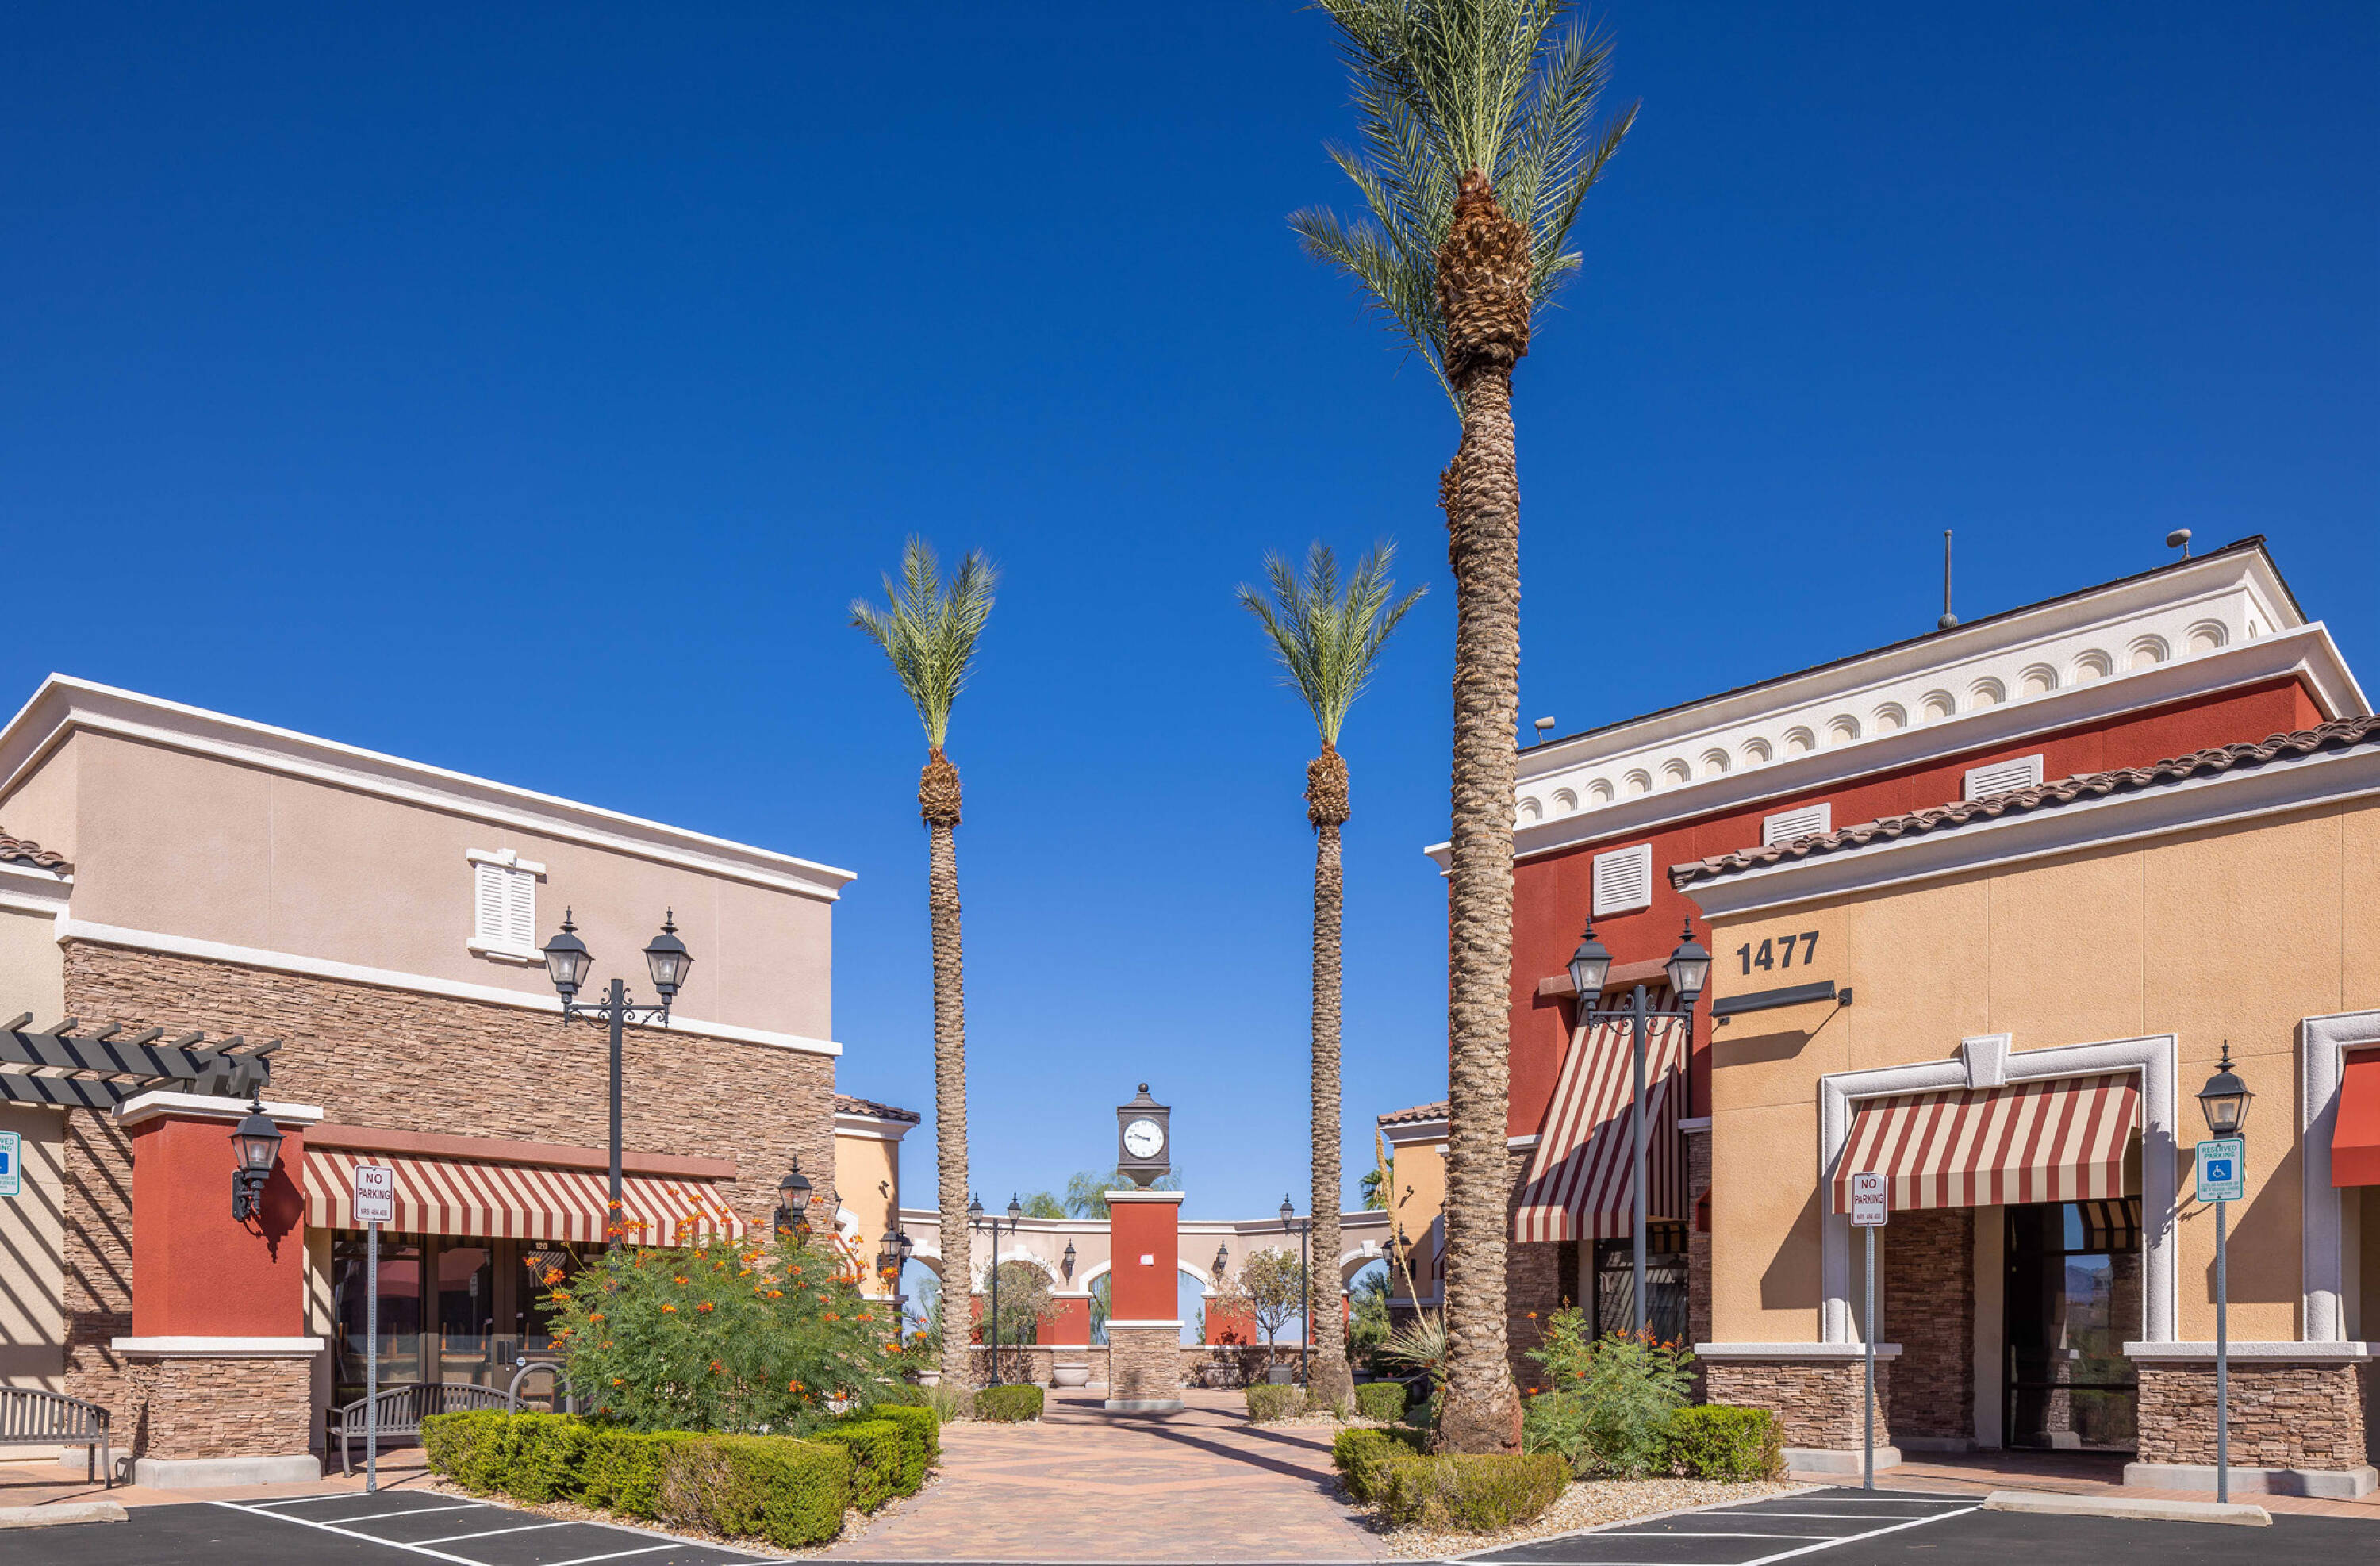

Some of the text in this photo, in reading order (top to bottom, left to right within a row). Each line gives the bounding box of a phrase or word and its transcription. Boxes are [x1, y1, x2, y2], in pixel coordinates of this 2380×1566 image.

[1736, 931, 1819, 976] 1477
[2202, 1145, 2237, 1153] RESERVED
[366, 1173, 382, 1184] NO
[1861, 1178, 1877, 1189] NO
[358, 1188, 390, 1200] PARKING
[1854, 1193, 1884, 1204] PARKING
